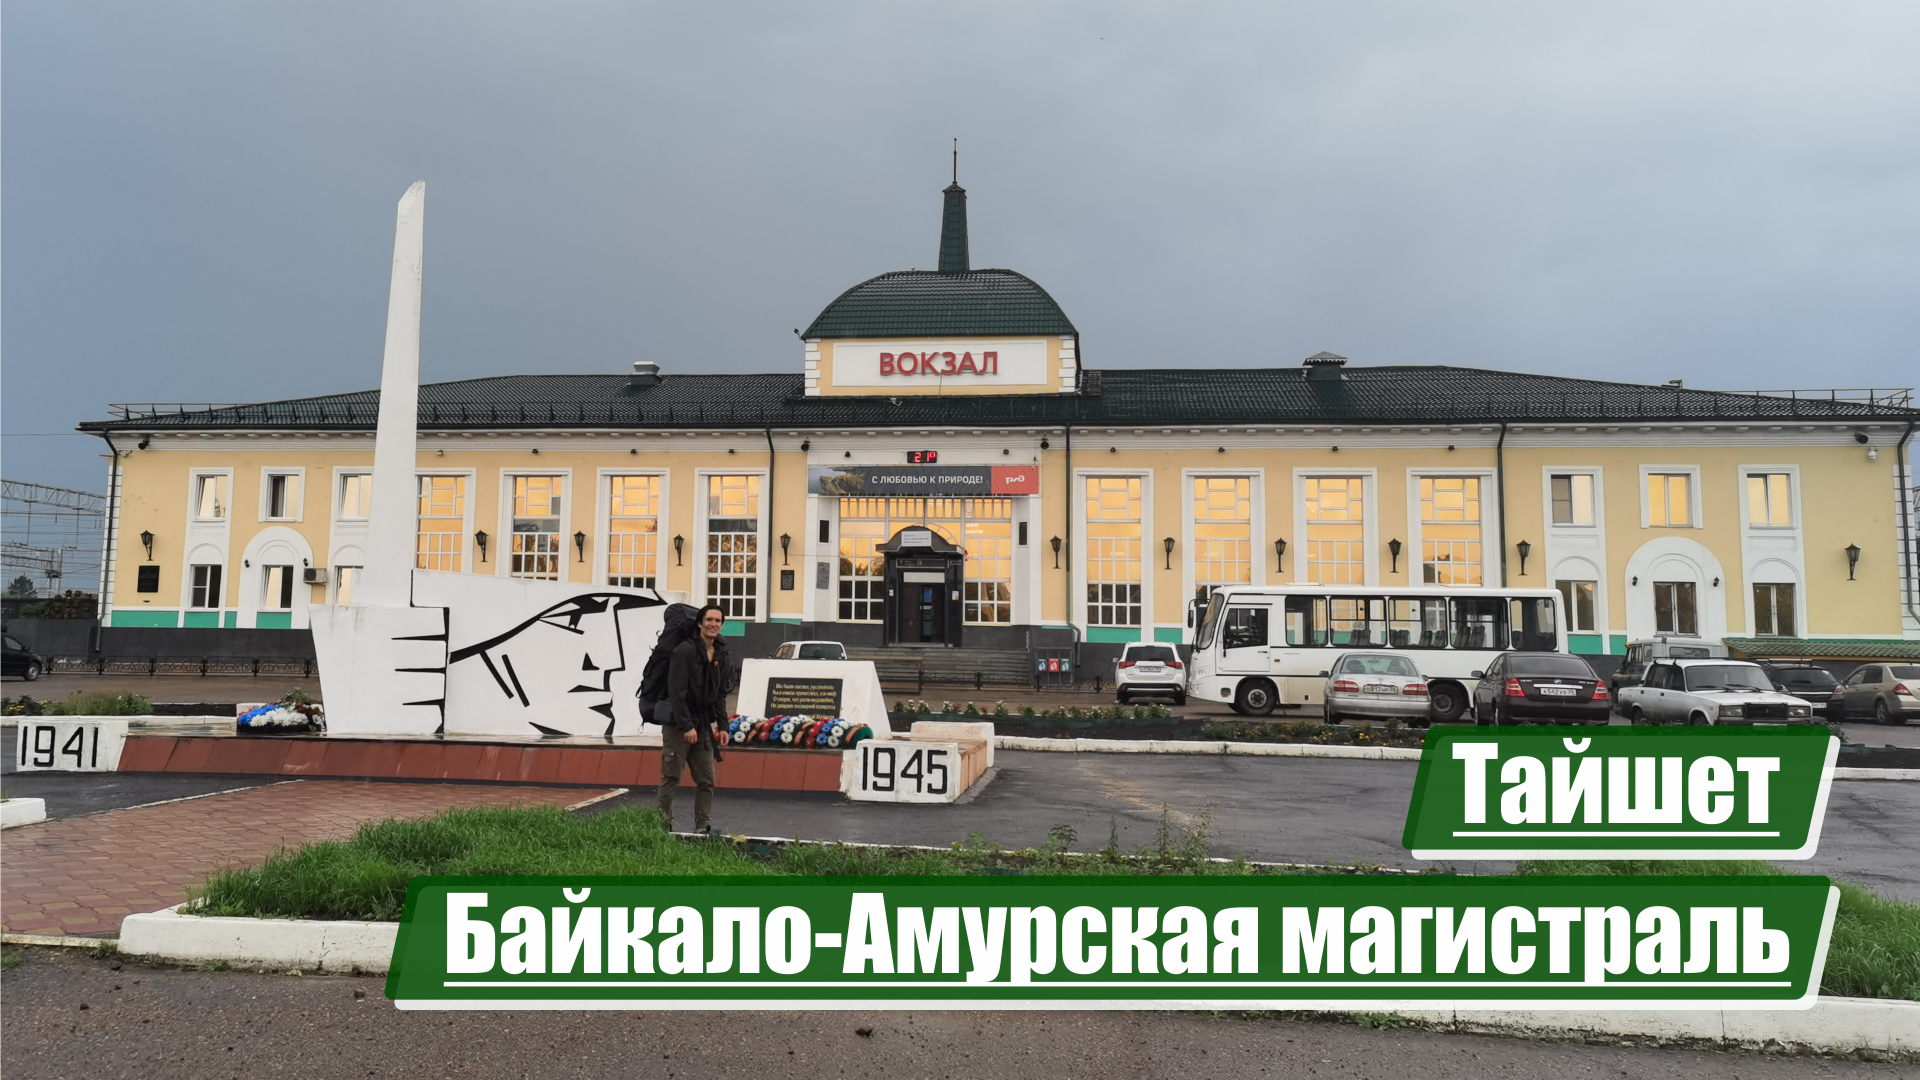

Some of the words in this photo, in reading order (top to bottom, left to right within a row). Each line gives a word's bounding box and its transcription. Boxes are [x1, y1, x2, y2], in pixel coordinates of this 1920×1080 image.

[880, 352, 998, 375] ВОКЗАЛ
[871, 476, 878, 484] С
[880, 476, 927, 484] ЛЮБОВЬЮ
[930, 476, 936, 484] К
[938, 476, 984, 485] ПРИРОДЕ!
[21, 725, 99, 768] 1941
[862, 746, 948, 795] 1945
